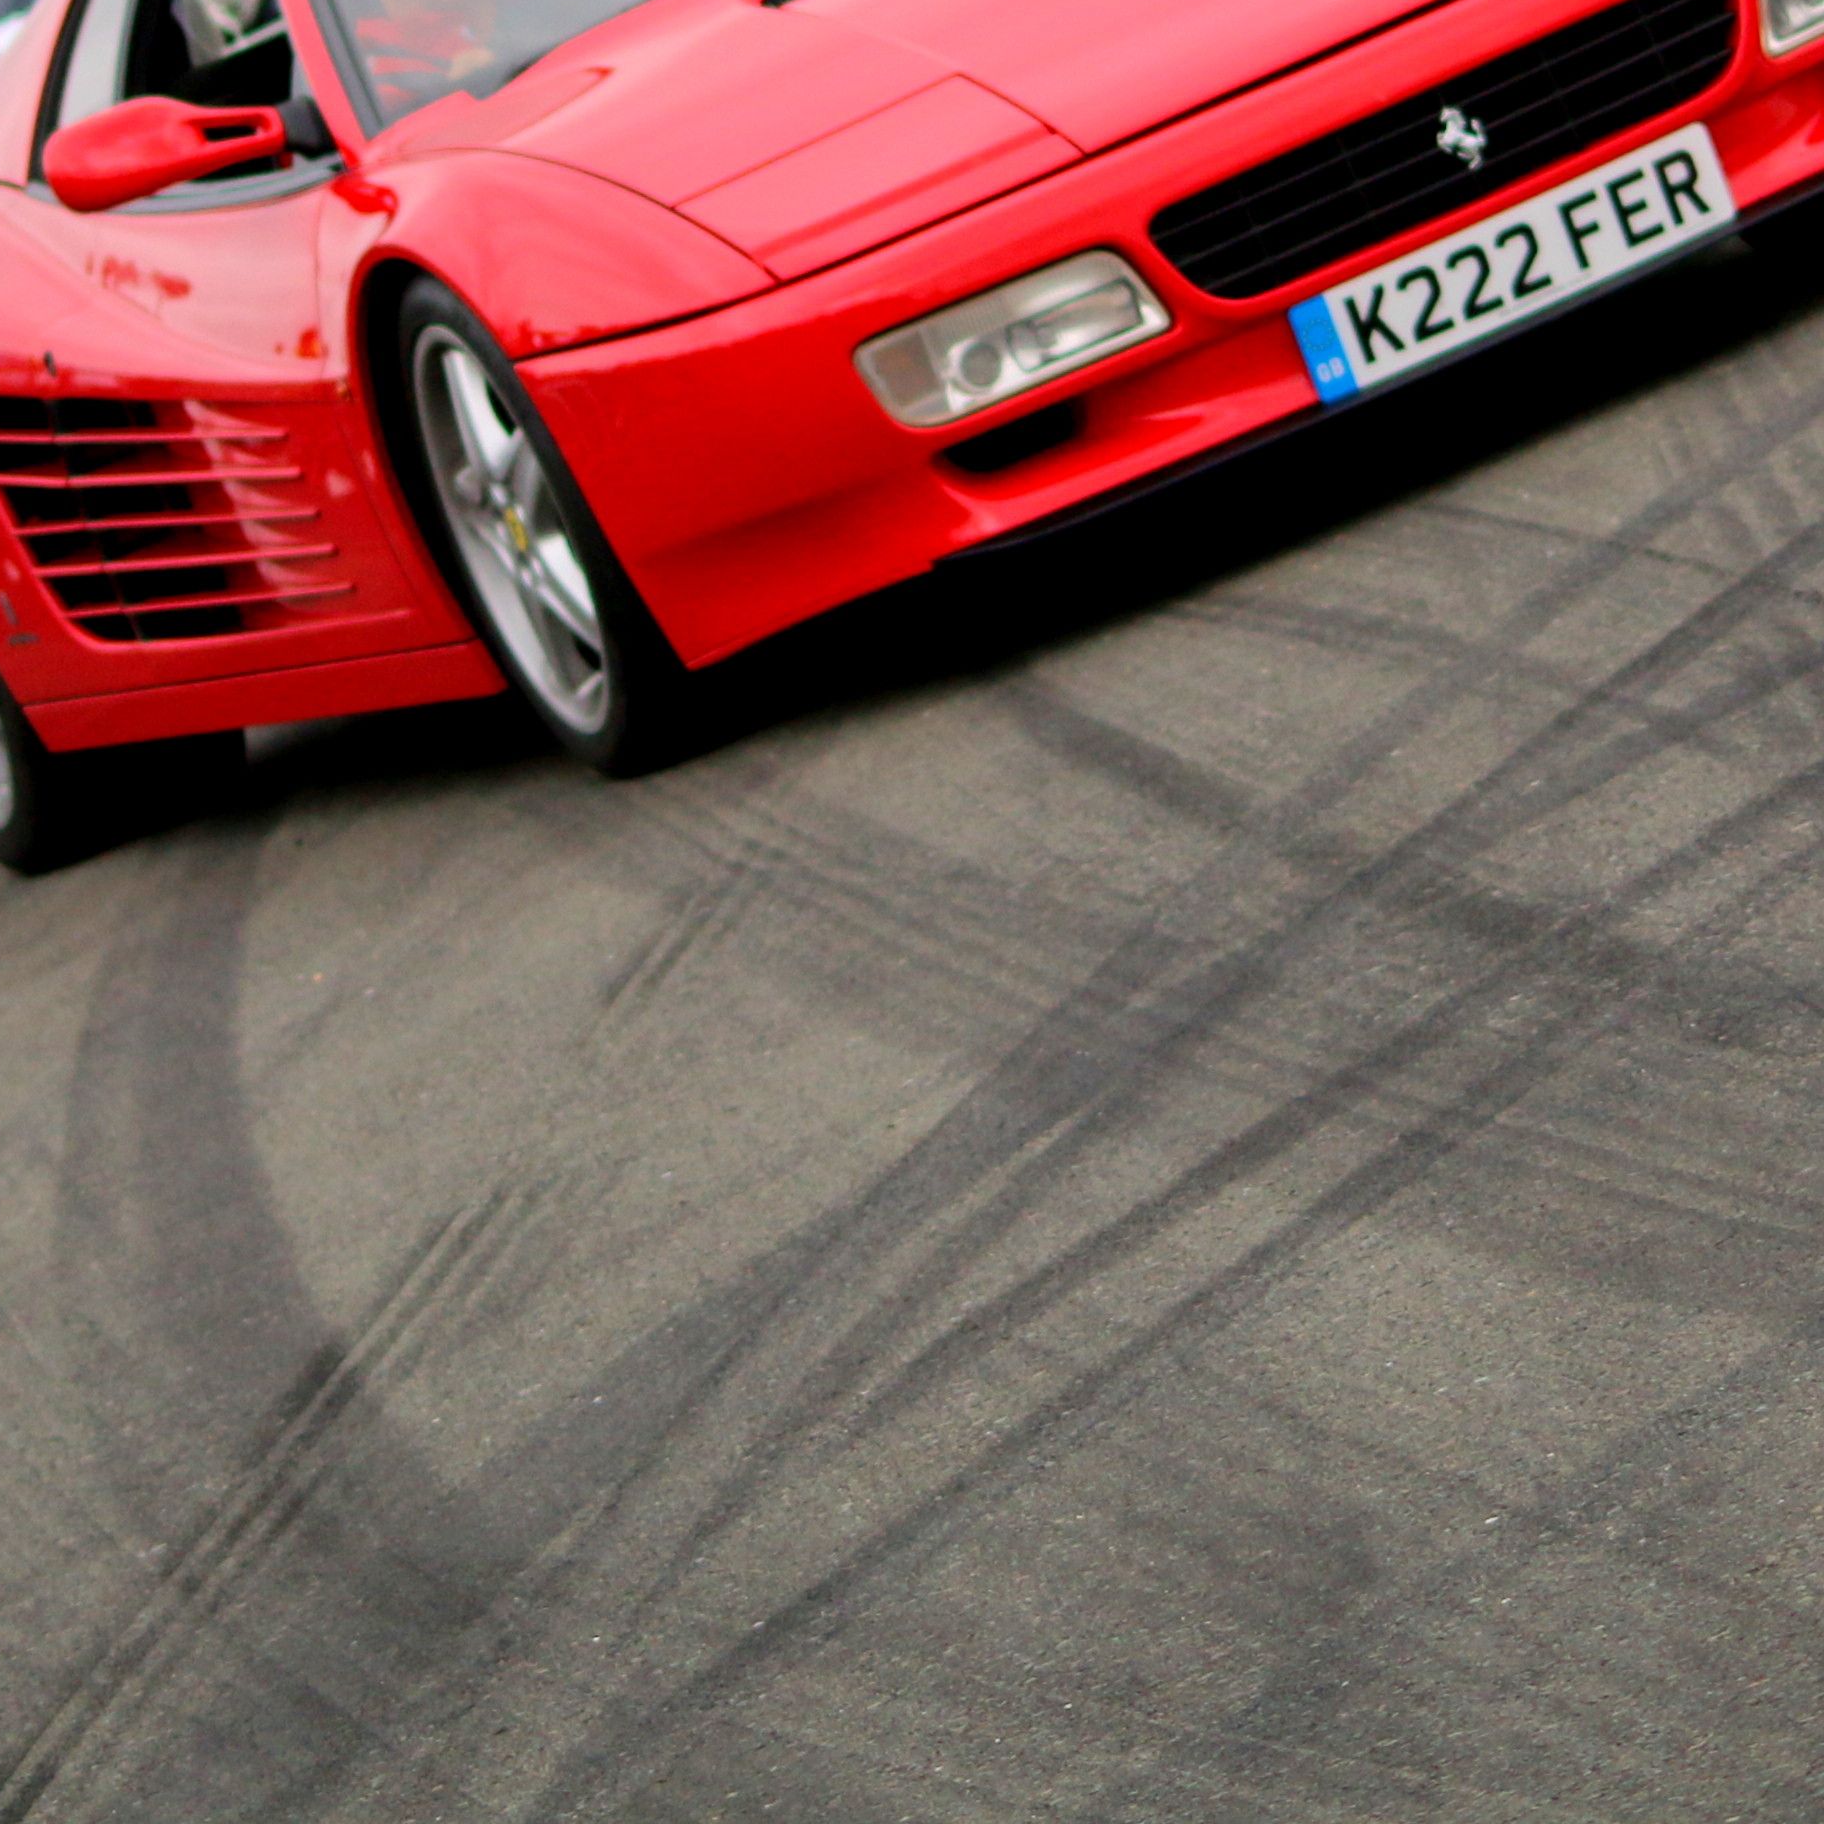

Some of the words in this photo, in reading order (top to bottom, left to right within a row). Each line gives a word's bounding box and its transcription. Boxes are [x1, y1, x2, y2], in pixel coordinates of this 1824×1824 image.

[1343, 223, 1552, 364] K222
[1557, 148, 1711, 270] FER
[1316, 356, 1345, 383] GB
